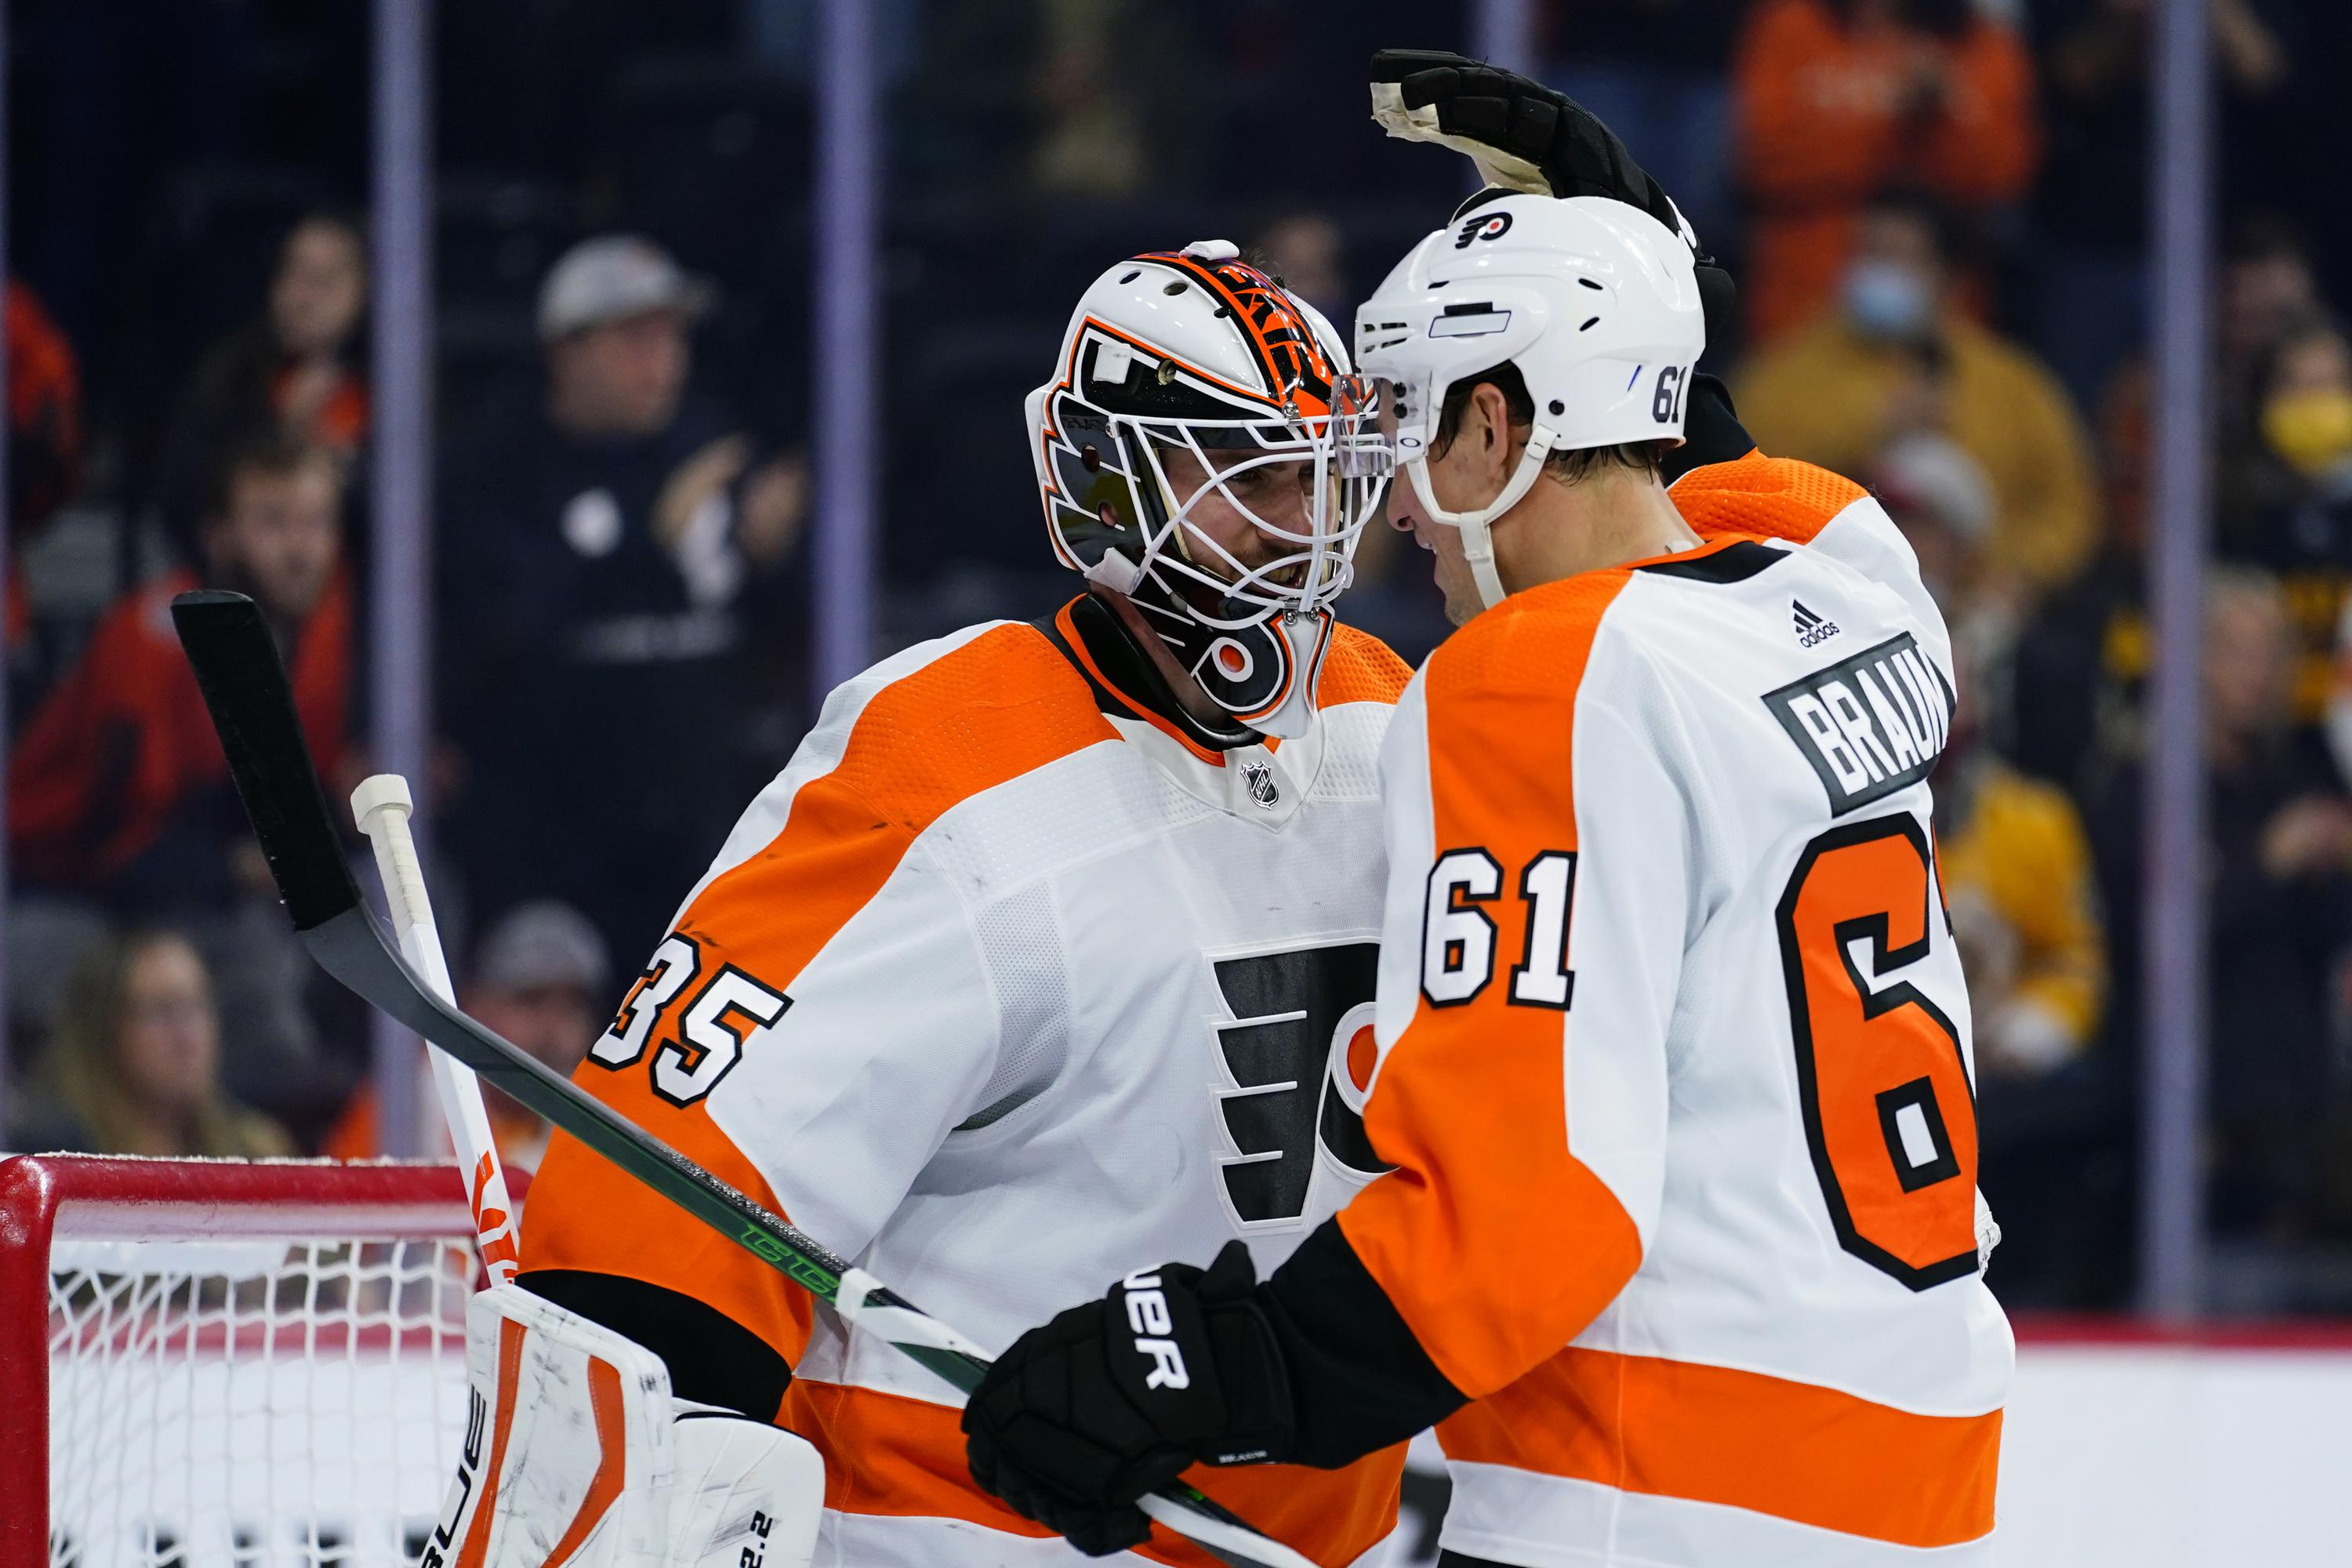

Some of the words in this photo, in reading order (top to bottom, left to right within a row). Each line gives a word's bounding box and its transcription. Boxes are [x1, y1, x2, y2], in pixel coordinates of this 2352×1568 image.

[1652, 365, 1687, 424] 61
[1800, 622, 1839, 648] adidas
[1787, 644, 1950, 797] BRAUN
[1255, 772, 1269, 799] NHL
[1420, 846, 1577, 1012] 61
[586, 931, 794, 1109] 35
[1775, 811, 1979, 1292] 6
[740, 1221, 840, 1307] CC
